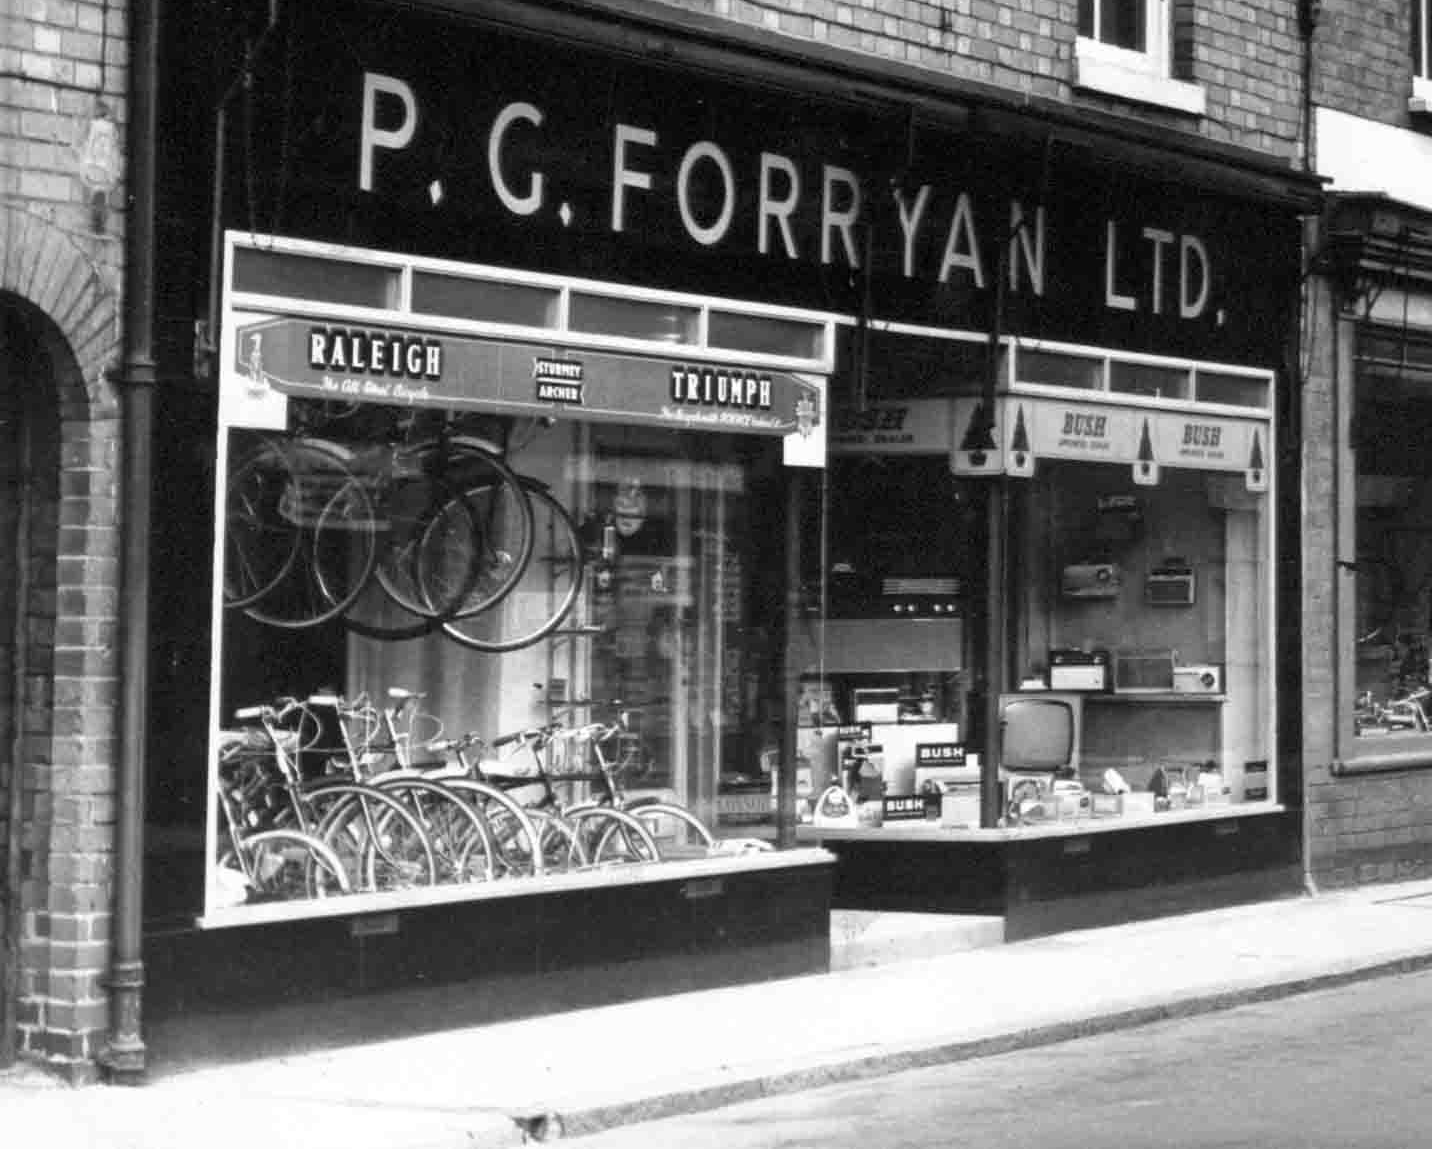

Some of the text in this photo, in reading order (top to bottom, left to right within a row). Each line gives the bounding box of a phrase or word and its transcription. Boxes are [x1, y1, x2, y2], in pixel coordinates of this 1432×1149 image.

[360, 71, 1225, 327] P. G. FORRYAN LTD.
[310, 331, 441, 377] RALEIGH
[671, 370, 771, 407] TRIUMPH
[1061, 410, 1108, 438] BUSH
[1181, 423, 1222, 447] BUSH
[920, 746, 964, 759] BUSH
[886, 798, 925, 813] BUSH
